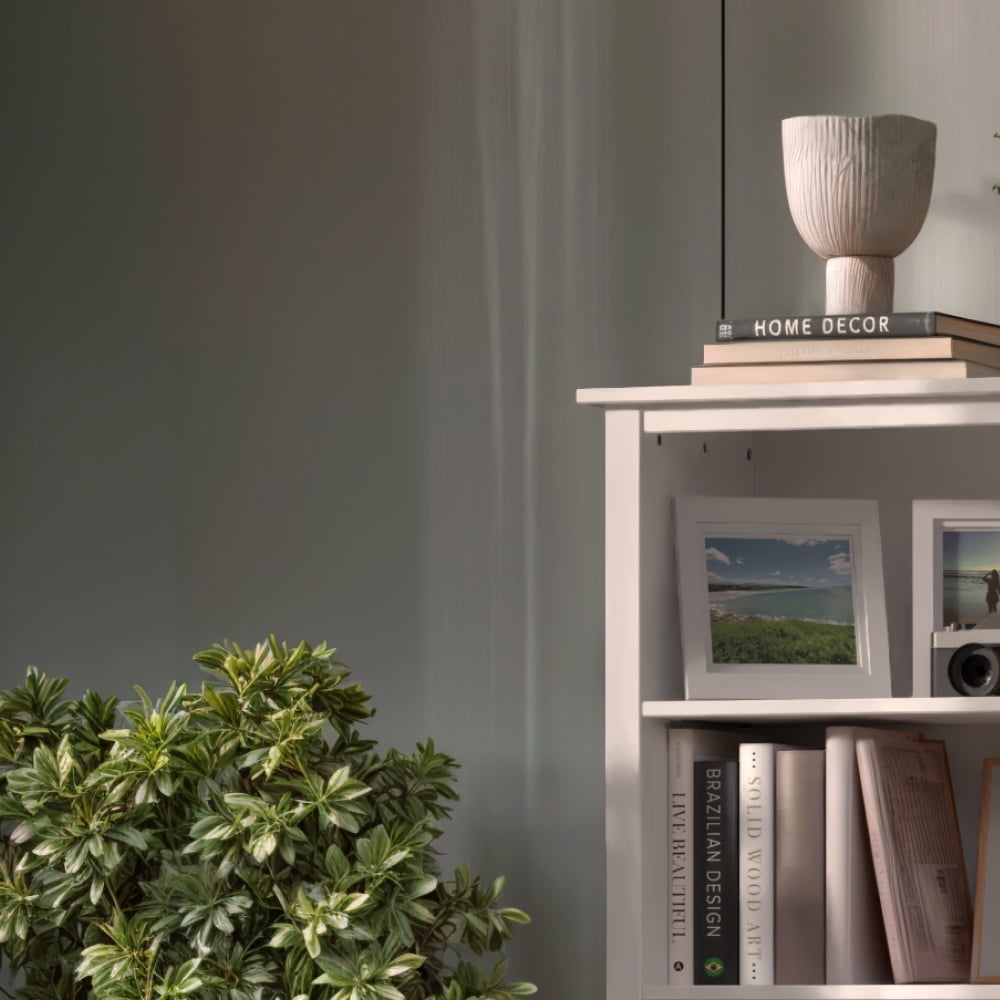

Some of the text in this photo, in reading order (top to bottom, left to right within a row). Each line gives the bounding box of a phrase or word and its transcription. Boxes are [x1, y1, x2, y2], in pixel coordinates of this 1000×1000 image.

[754, 318, 812, 337] HOME
[822, 316, 890, 335] DECOR
[672, 792, 686, 835] LIVE
[706, 768, 721, 938] BRAZILIAN DESIGN
[672, 839, 686, 942] BEAUTIFUL
[746, 776, 762, 959] SOLID WOOD ART
